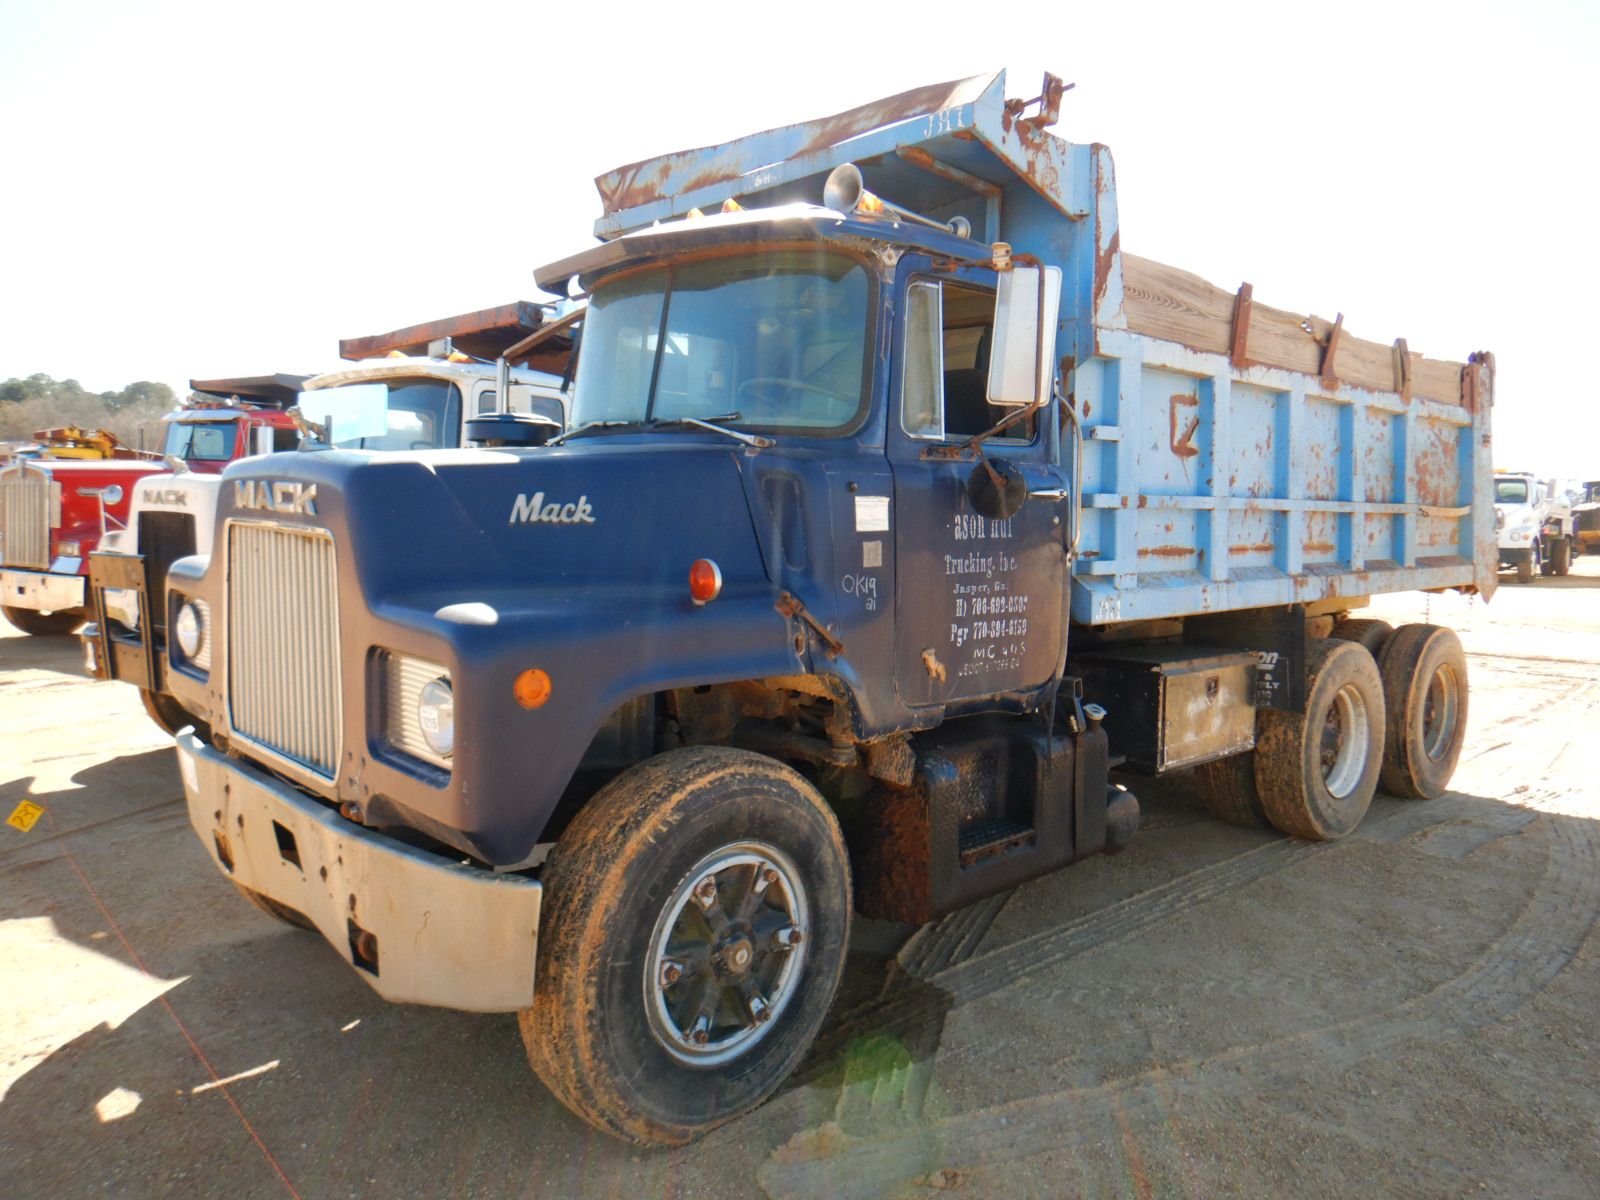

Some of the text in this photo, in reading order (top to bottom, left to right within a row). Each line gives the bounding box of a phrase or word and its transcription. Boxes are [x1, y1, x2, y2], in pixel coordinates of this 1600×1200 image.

[143, 489, 187, 506] MACK
[234, 480, 319, 516] MACK
[509, 491, 596, 524] Mack
[946, 514, 986, 541] ason
[950, 624, 968, 647] Pgr
